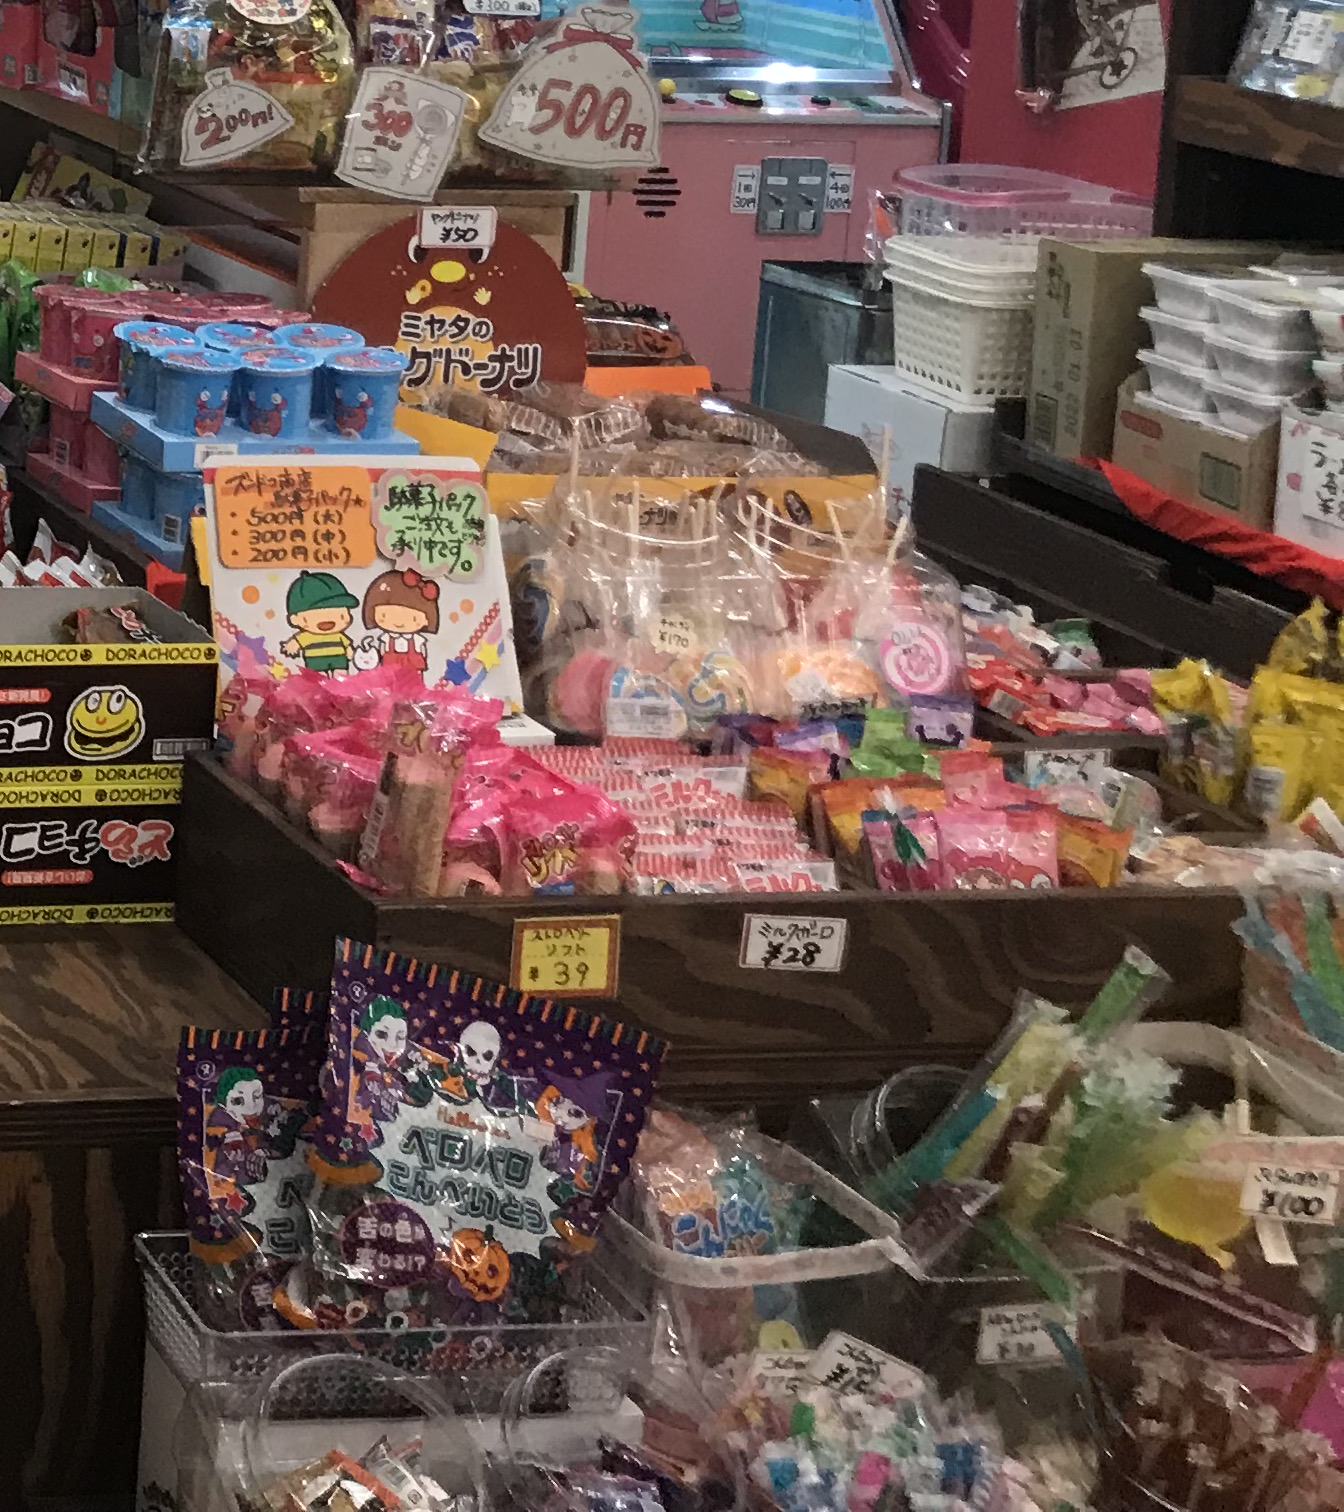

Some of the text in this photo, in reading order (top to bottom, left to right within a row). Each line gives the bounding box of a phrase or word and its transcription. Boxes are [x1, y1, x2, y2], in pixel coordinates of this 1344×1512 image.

[362, 101, 413, 136] 300
[528, 77, 648, 152] 500円
[439, 226, 480, 244] ¥50
[399, 311, 494, 343] ミヤタの
[403, 343, 542, 390] グドーナツ
[104, 646, 203, 662] DORACHOCO
[110, 788, 183, 804] RACHOCO
[0, 818, 175, 868] どらチョコ
[100, 905, 173, 922] RACHOCO
[762, 941, 822, 968] ¥28
[1258, 1188, 1325, 1218] ¥100
